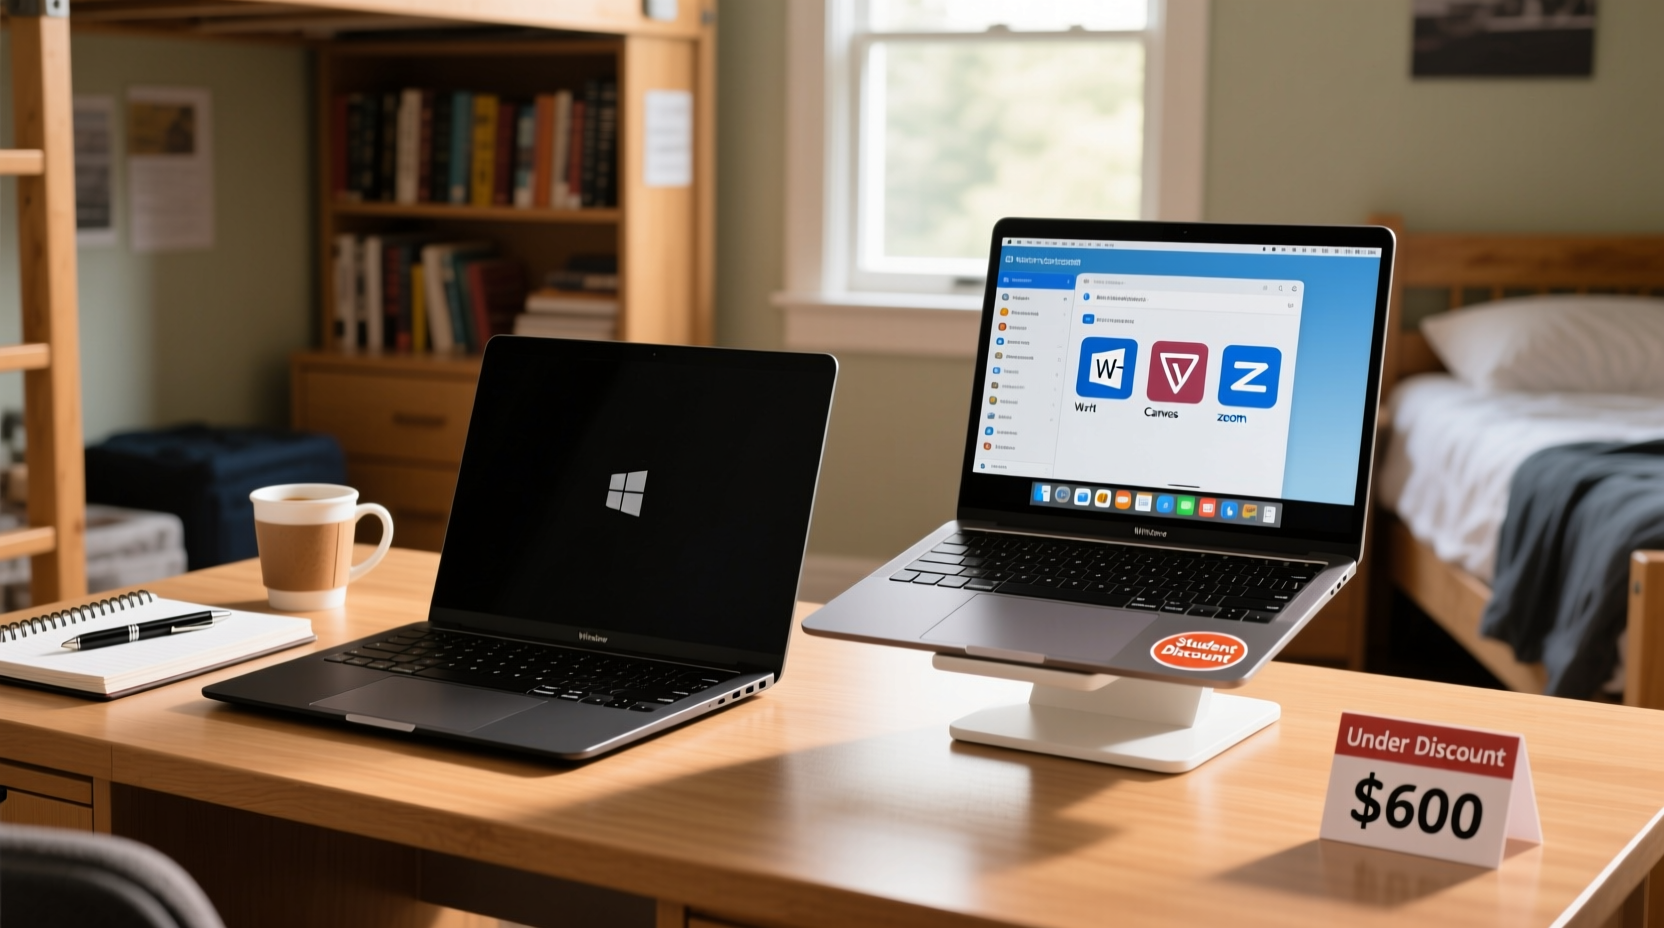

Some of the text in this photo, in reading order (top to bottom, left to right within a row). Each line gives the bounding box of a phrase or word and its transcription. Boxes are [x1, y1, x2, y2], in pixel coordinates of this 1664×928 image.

[1230, 361, 1269, 393] Z
[1161, 644, 1232, 664] Discount
[1176, 637, 1239, 654] Student
[1347, 726, 1507, 767] Under Discount
[1351, 771, 1483, 840] $600
